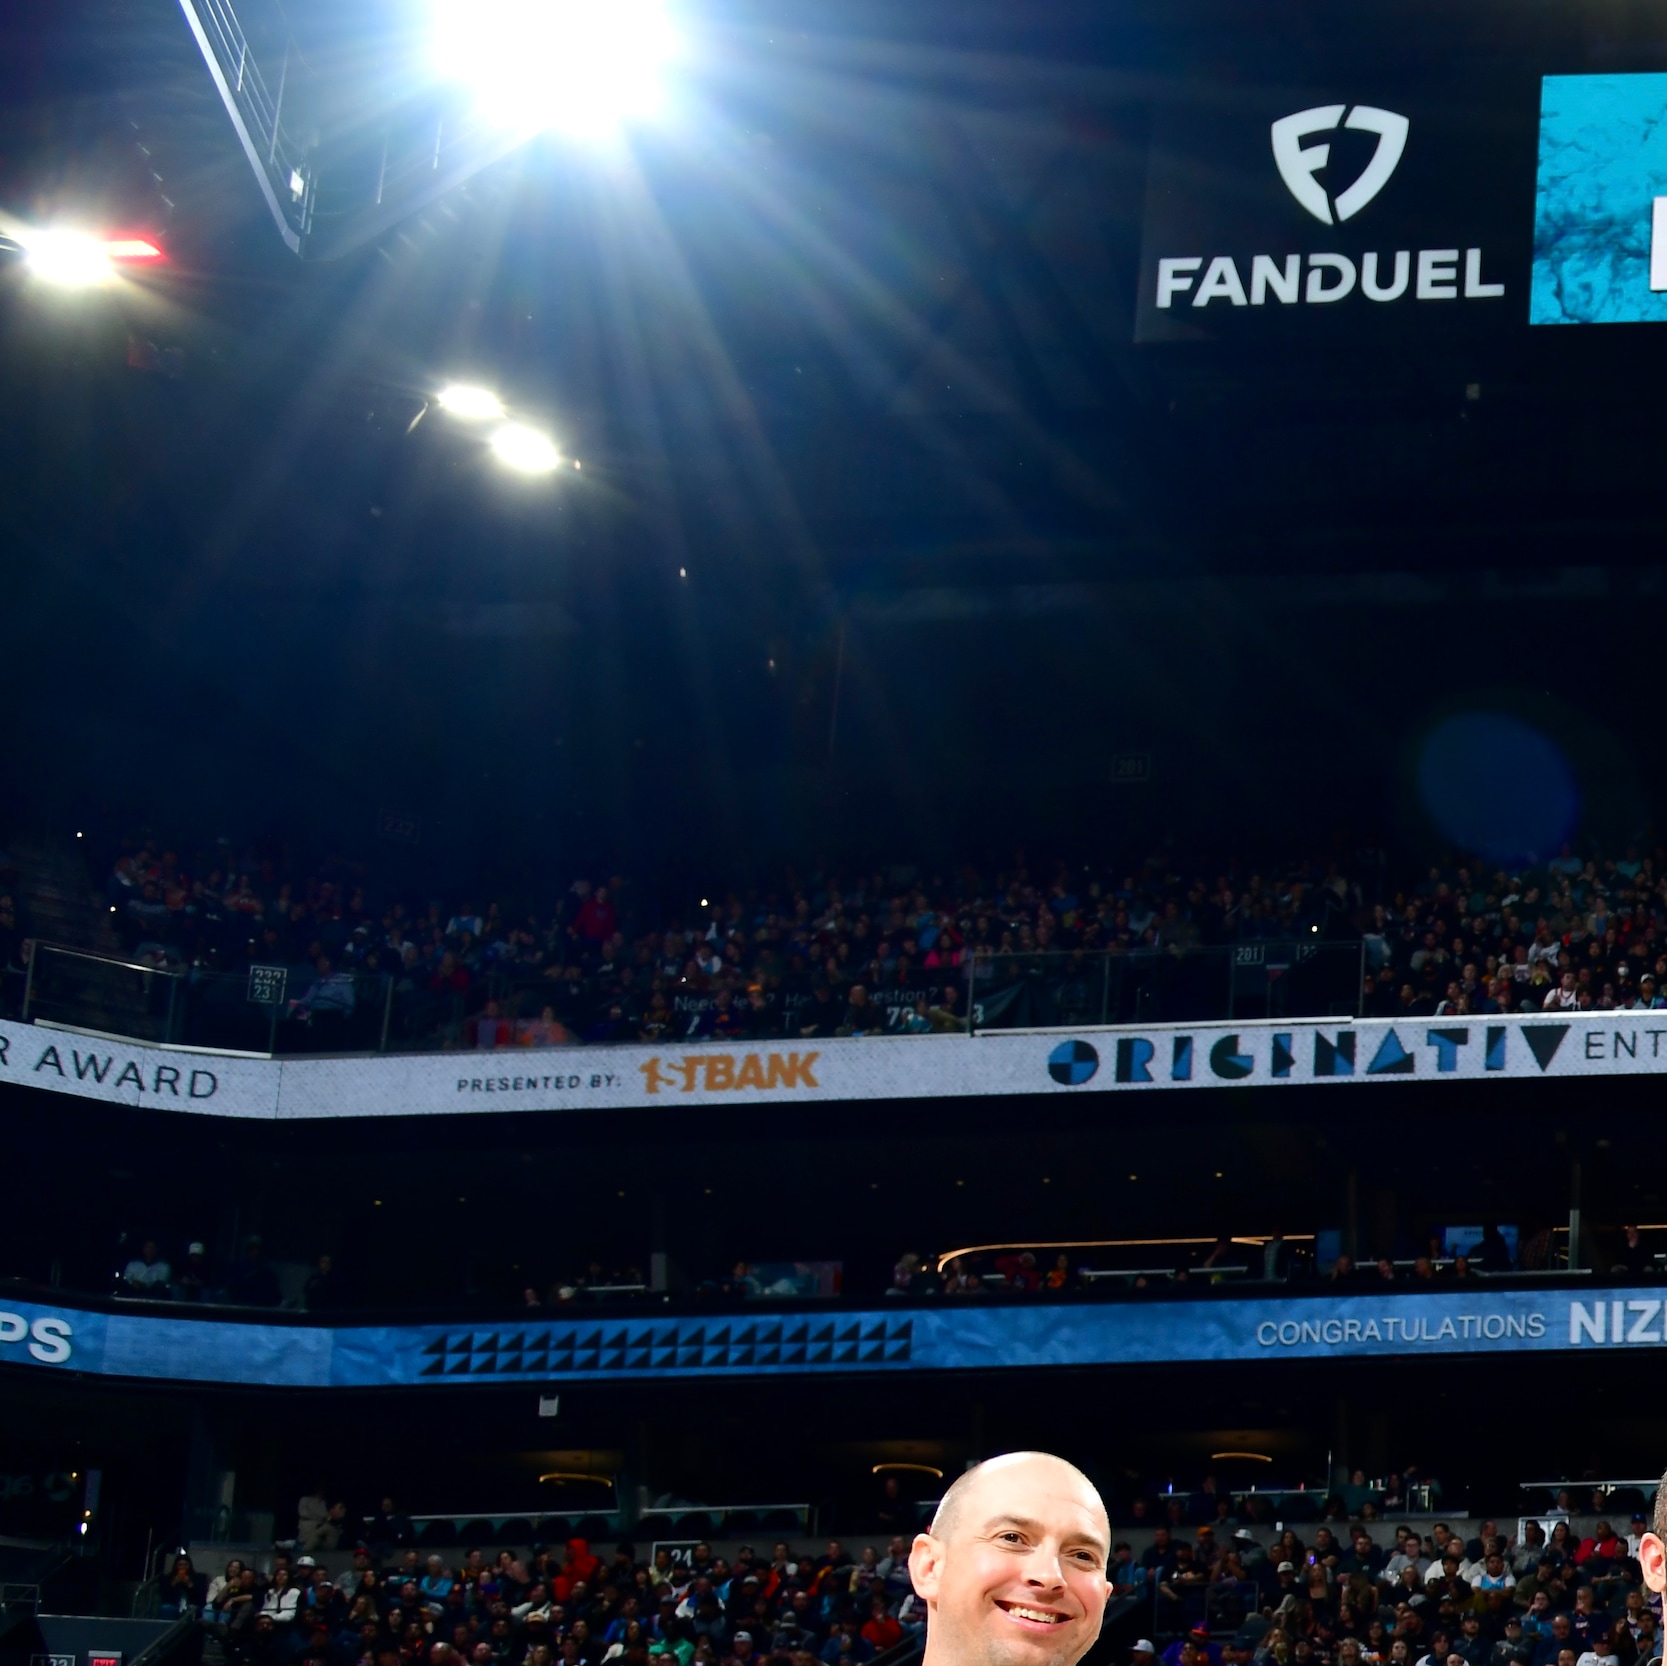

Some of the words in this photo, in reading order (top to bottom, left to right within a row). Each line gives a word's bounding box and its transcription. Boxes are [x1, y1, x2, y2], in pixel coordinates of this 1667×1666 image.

[1154, 248, 1506, 310] FANDUEL
[34, 1043, 220, 1100] AWARD
[456, 1075, 581, 1093] PRESENTED
[590, 1072, 622, 1090] BY:
[1257, 1312, 1546, 1346] CONGRATULATIONS
